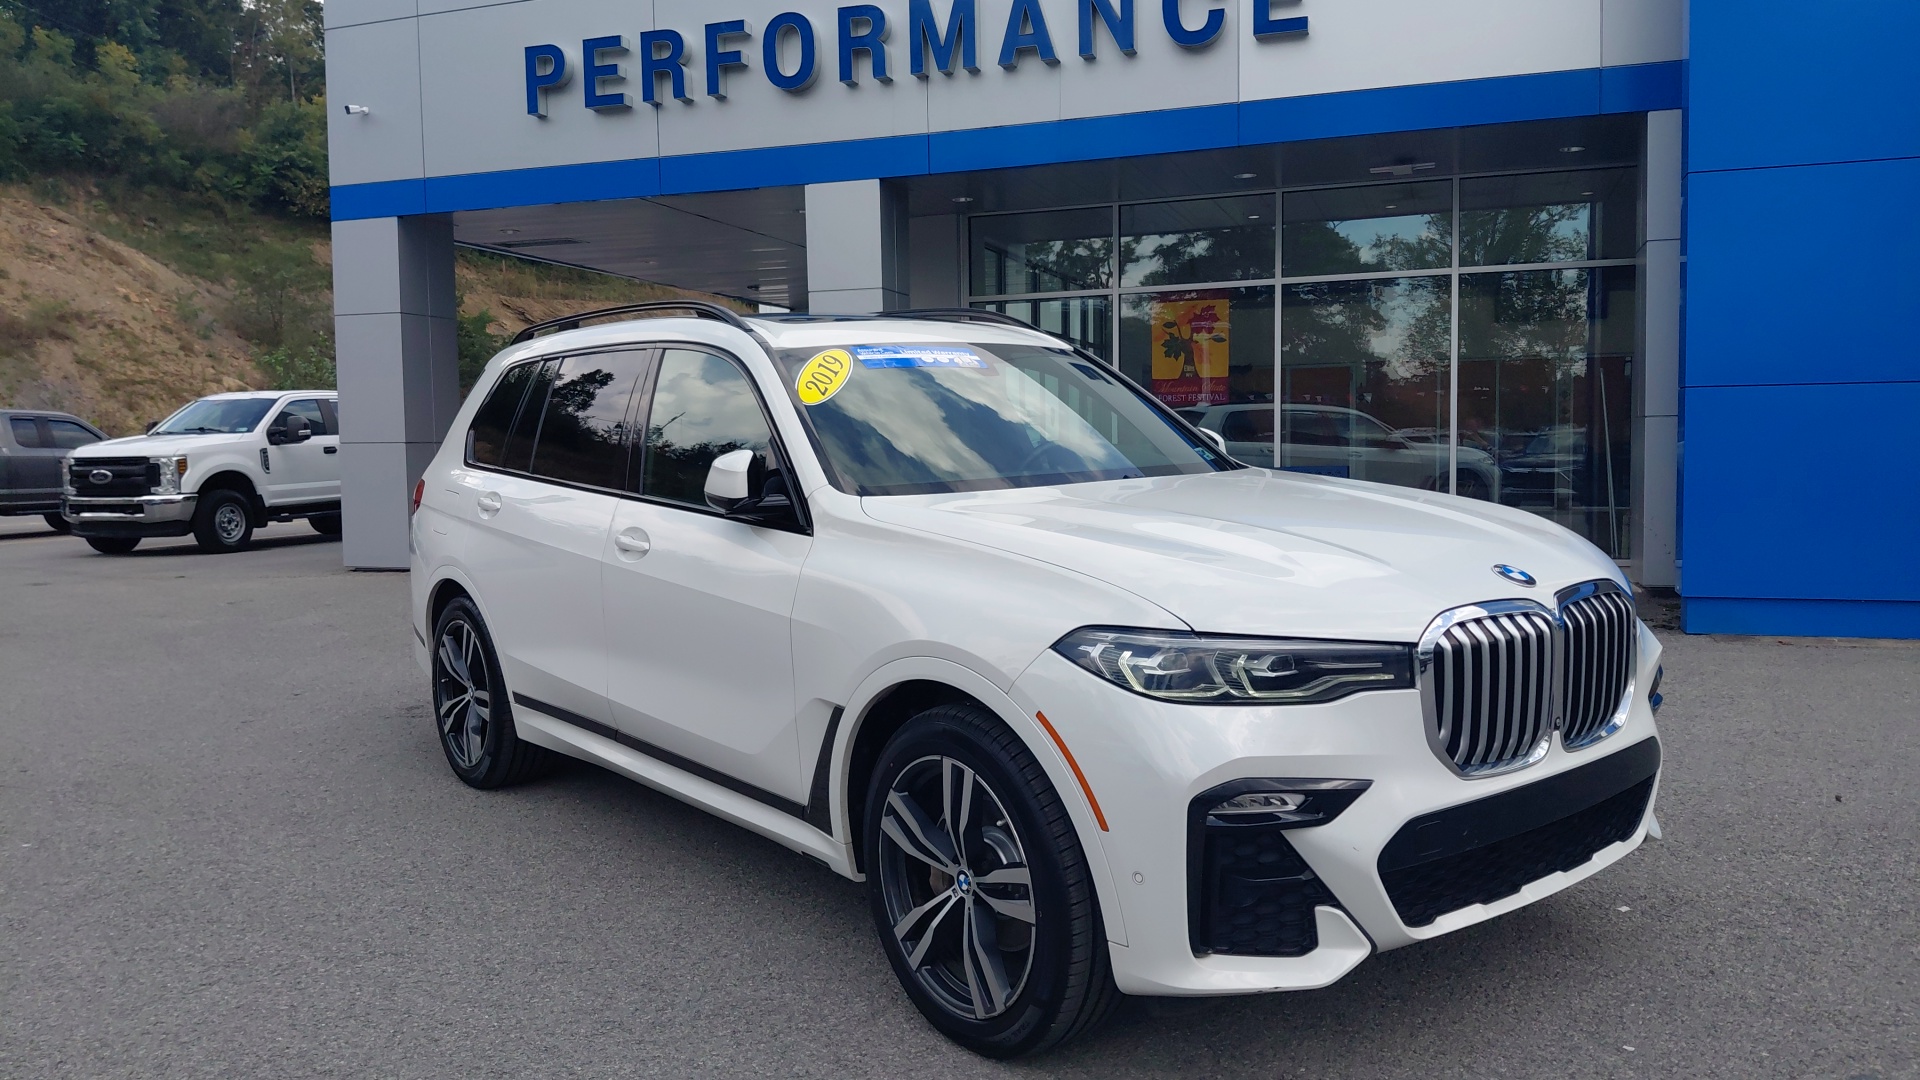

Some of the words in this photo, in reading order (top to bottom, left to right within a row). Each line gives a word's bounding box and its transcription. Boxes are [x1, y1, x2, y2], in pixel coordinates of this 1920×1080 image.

[805, 355, 843, 396] 2019
[1155, 381, 1198, 393] Mountain
[1202, 381, 1226, 392] State
